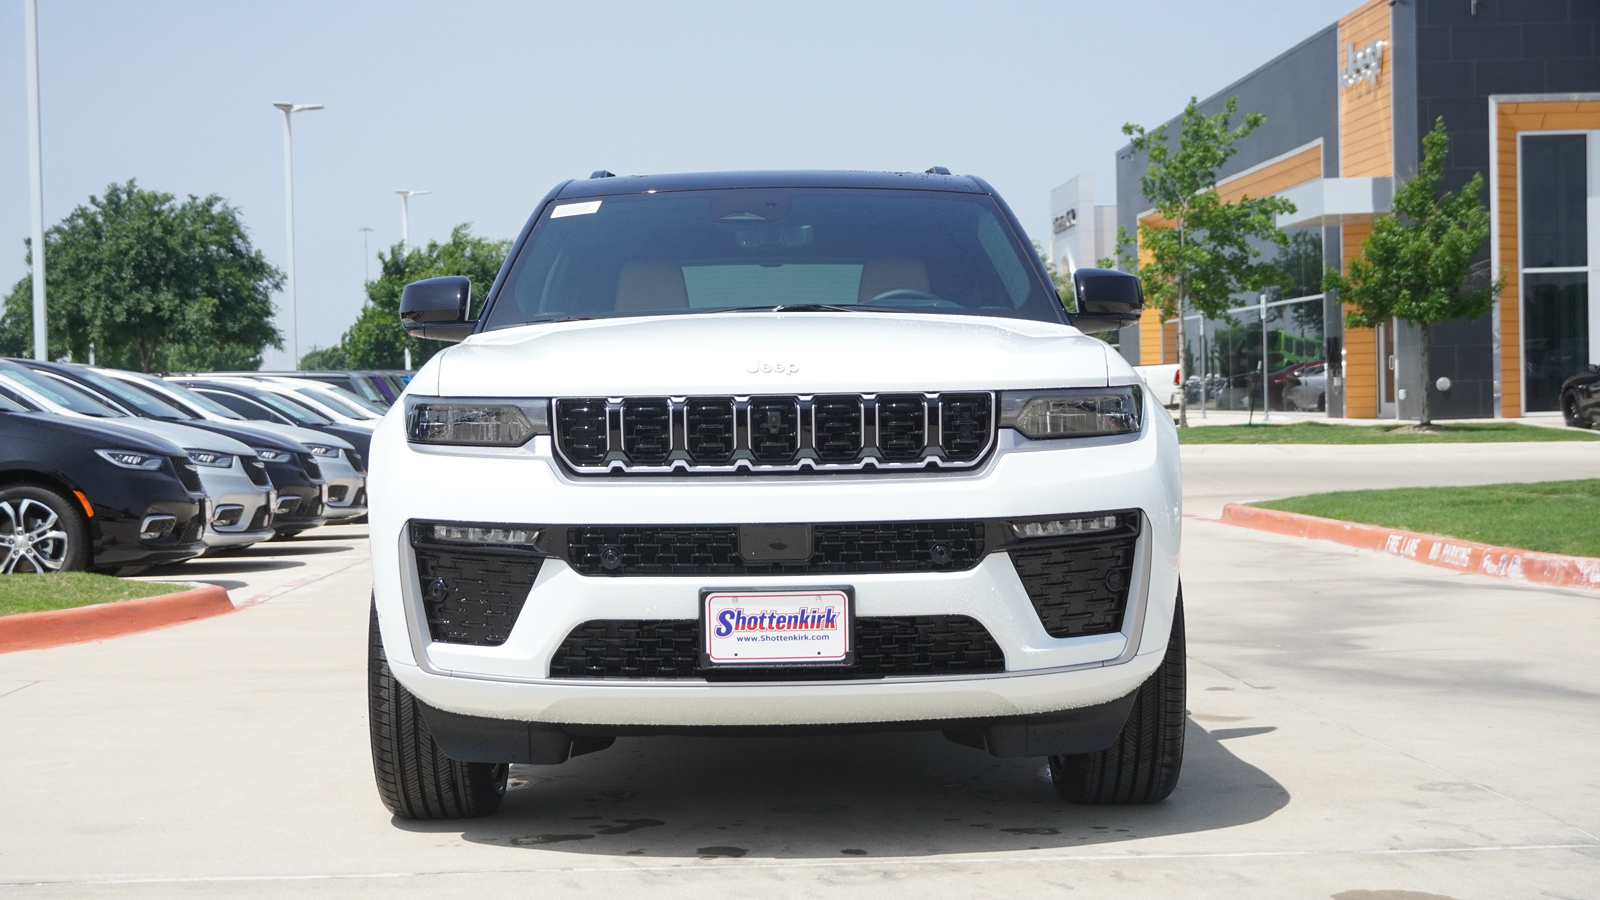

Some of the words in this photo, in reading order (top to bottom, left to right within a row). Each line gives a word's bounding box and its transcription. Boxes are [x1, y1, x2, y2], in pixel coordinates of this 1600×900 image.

[1343, 40, 1383, 88] Jeep
[745, 359, 799, 376] Jeep
[1385, 534, 1402, 553] FIRE
[1400, 536, 1421, 557] LANE
[1428, 542, 1442, 560] NO
[715, 607, 838, 638] Shottenkirk
[736, 633, 830, 642] www.Shottenkirk.com
